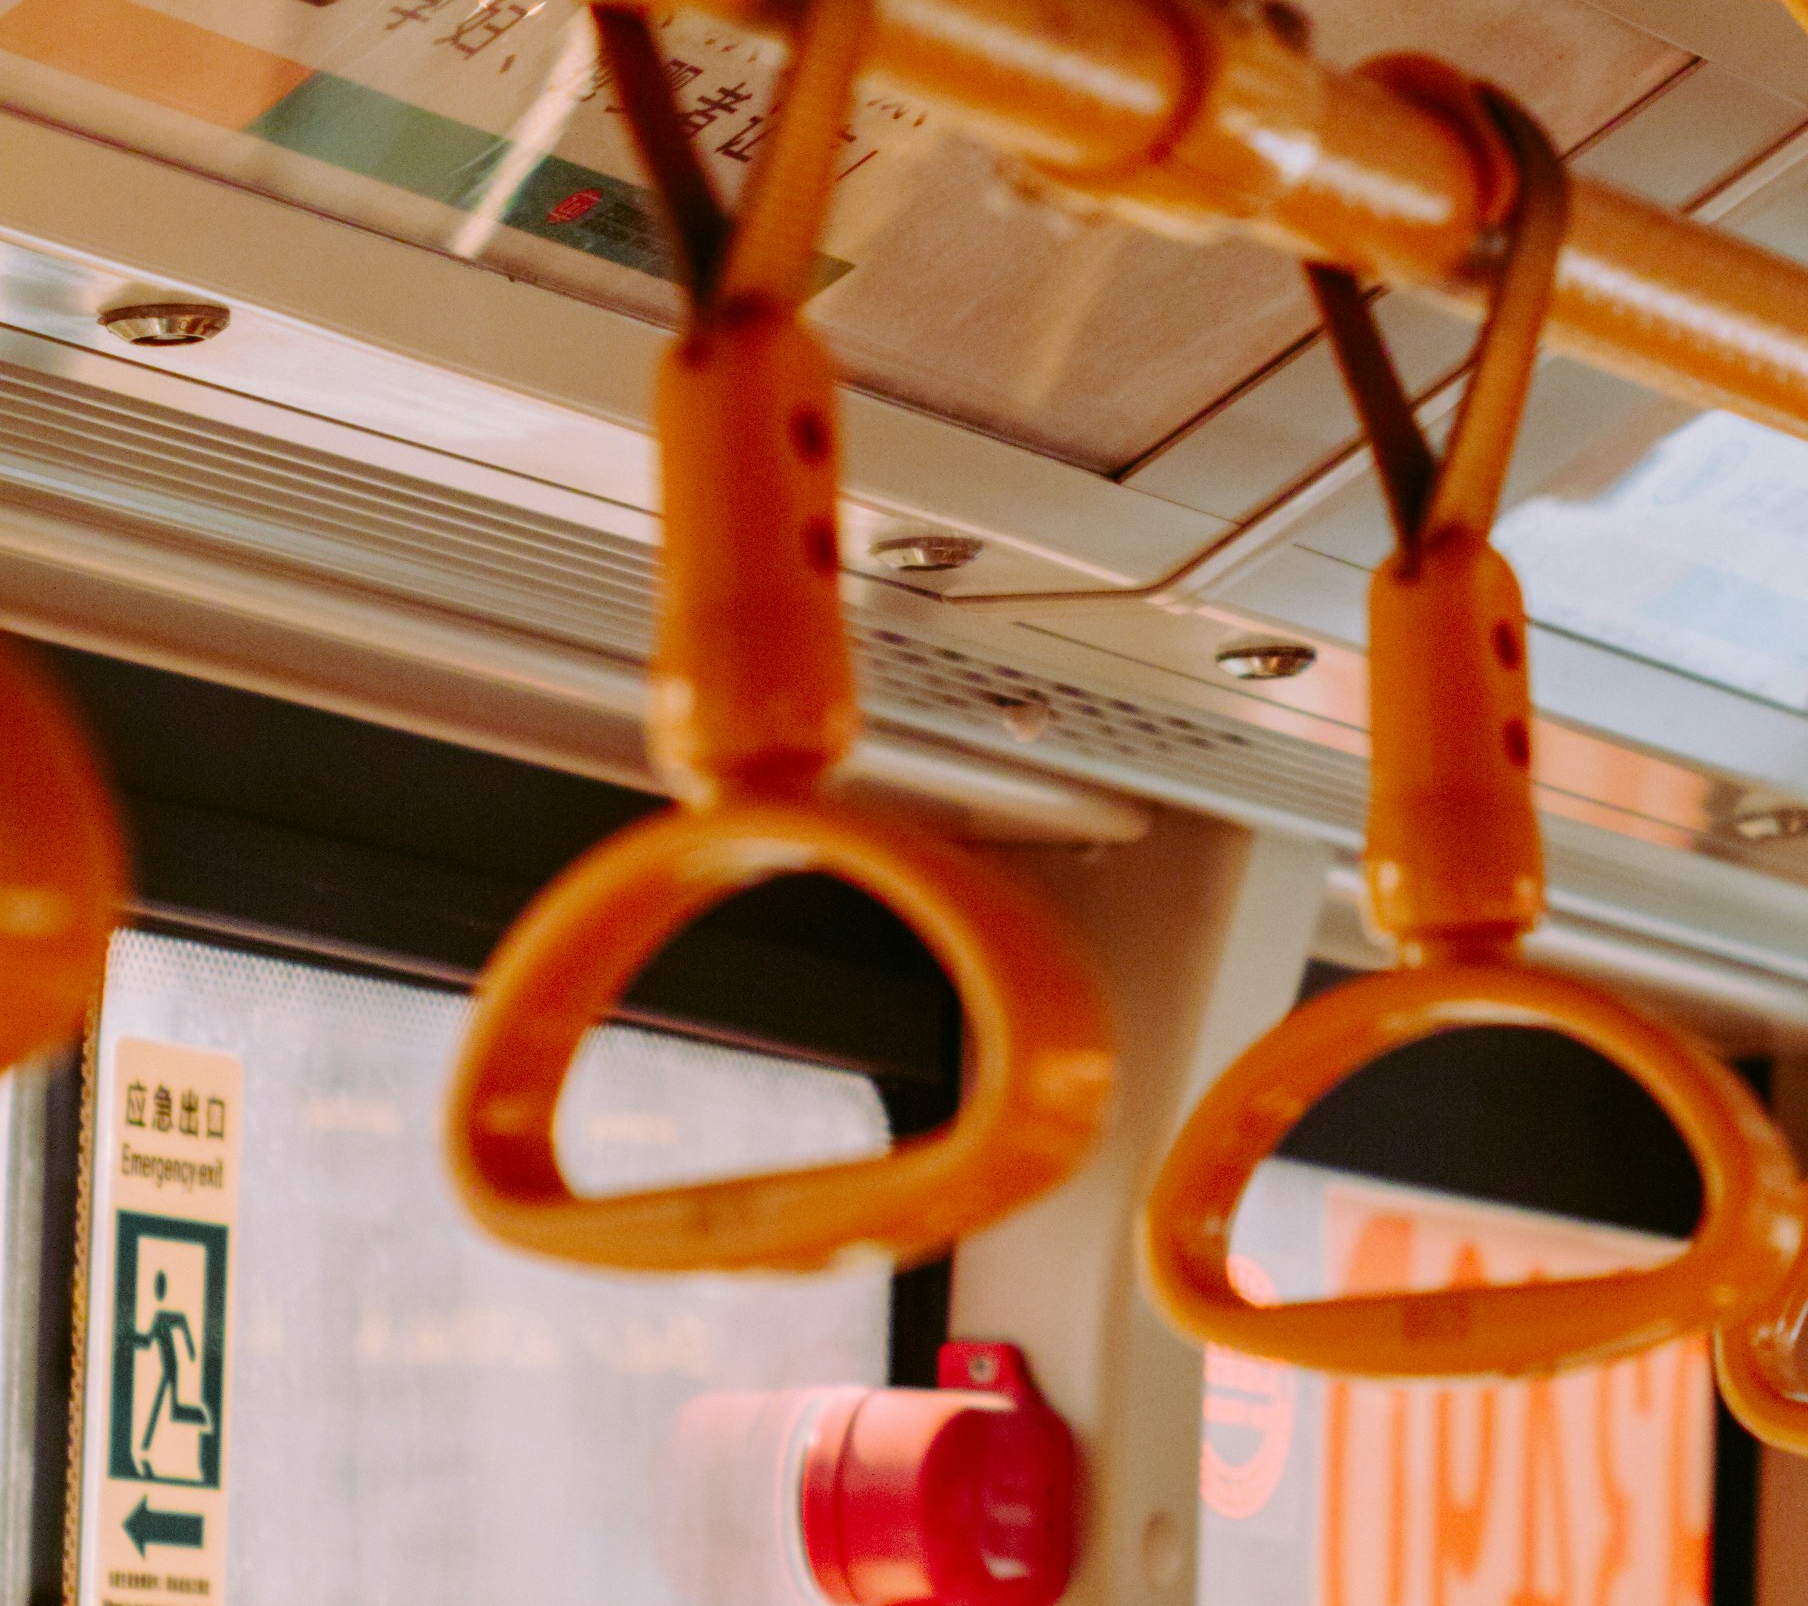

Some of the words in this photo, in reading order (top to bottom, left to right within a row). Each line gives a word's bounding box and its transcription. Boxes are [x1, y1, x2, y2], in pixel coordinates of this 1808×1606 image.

[125, 1080, 225, 1140] 应急出口
[121, 1143, 196, 1192] Emergency
[199, 1157, 223, 1189] exit
